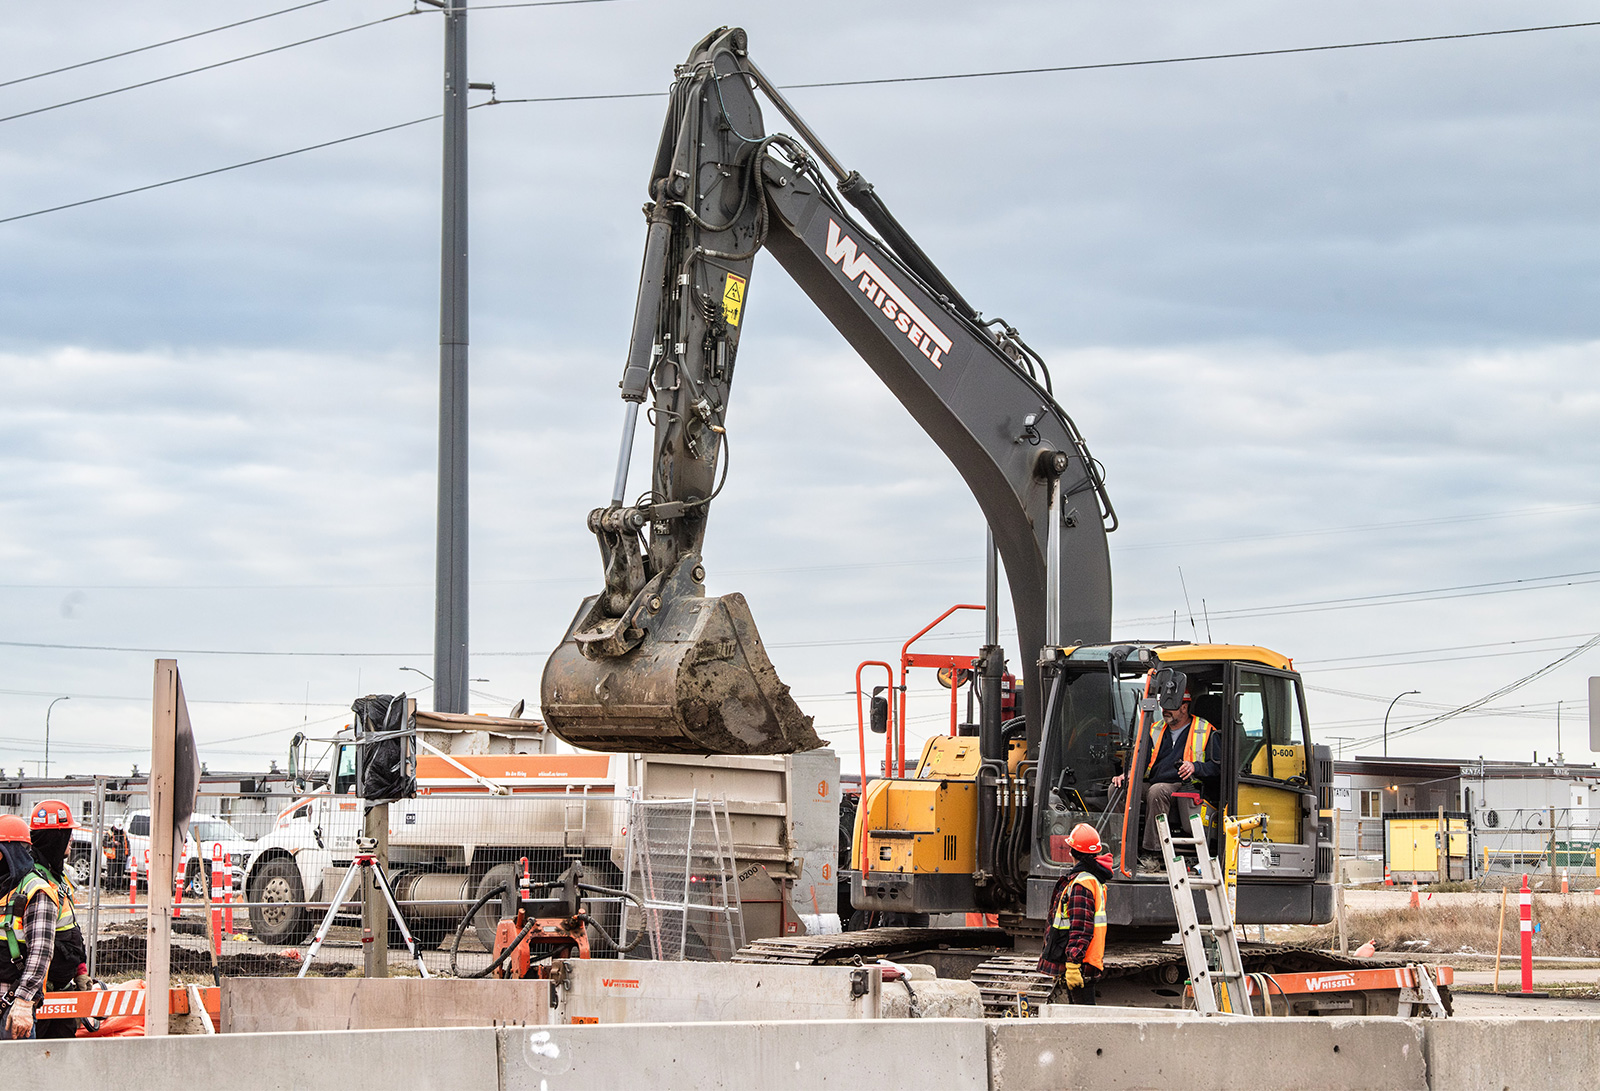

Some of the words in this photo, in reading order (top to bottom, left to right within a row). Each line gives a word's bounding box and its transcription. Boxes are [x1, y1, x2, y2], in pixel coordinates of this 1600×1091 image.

[825, 218, 954, 370] WHISSELL
[1306, 973, 1355, 990] WHISSELL
[36, 998, 78, 1014] HISSELL
